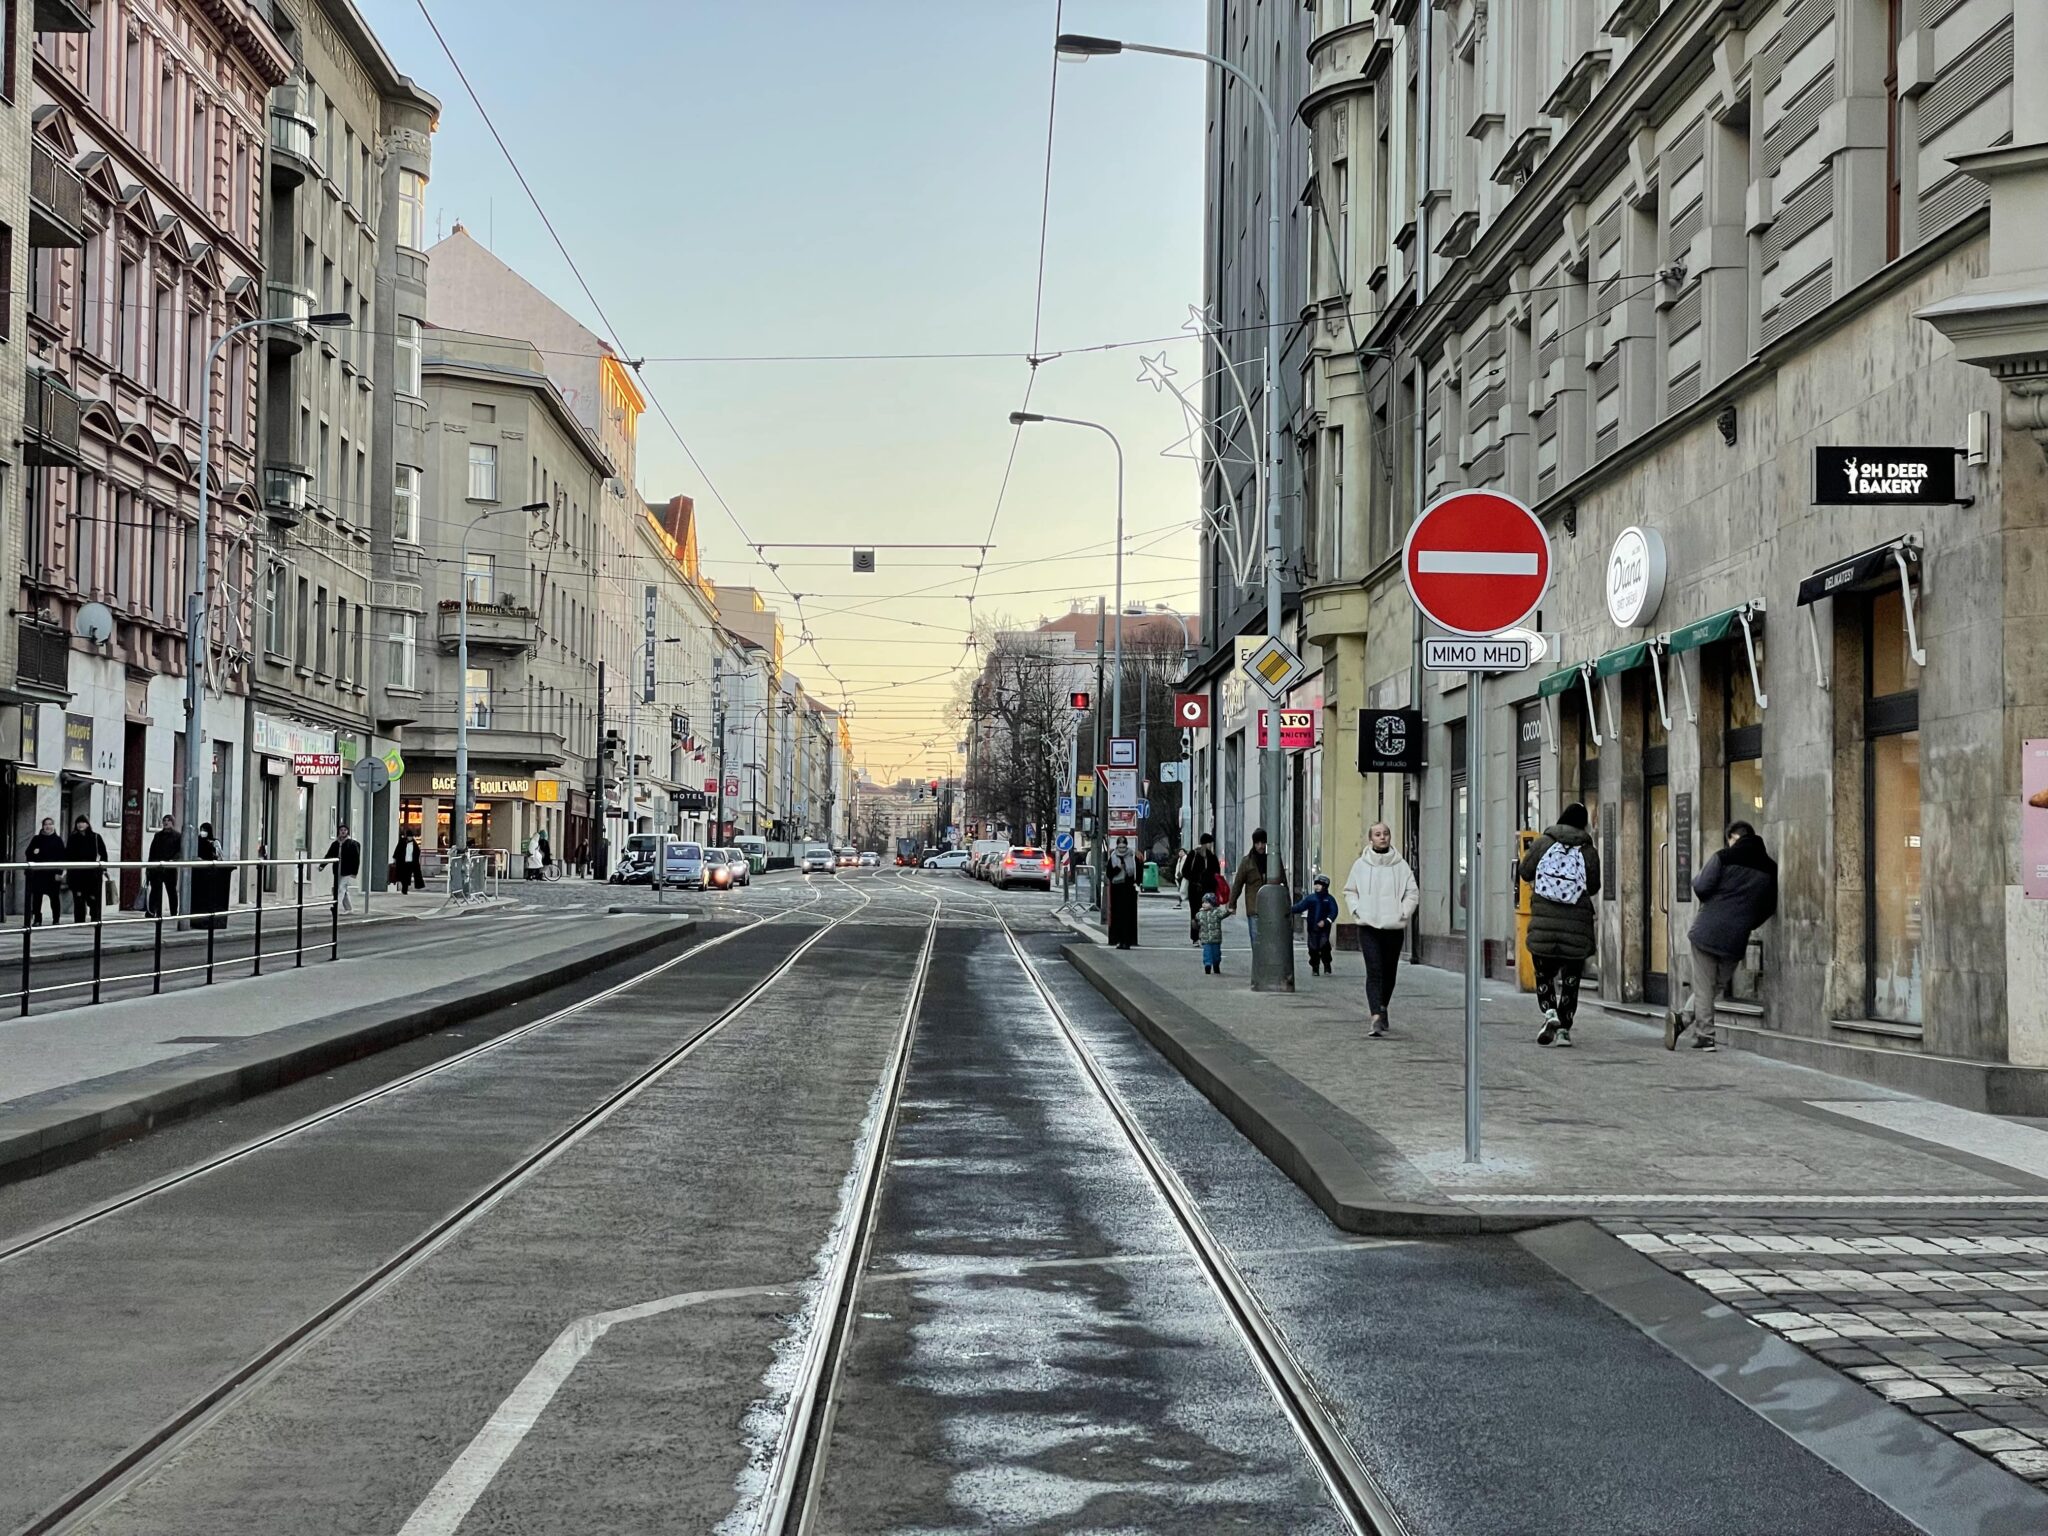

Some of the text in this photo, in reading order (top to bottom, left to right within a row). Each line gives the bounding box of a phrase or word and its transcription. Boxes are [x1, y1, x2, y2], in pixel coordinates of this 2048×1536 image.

[1860, 463, 1928, 478] OH DEER
[1859, 479, 1922, 494] BAKERY
[1613, 555, 1641, 595] Diana
[645, 596, 656, 691] HOTEL
[1433, 646, 1522, 662] MIMO MHD
[713, 666, 721, 739] HOTEL
[295, 755, 313, 764] NON
[319, 755, 340, 765] STOP
[1386, 759, 1407, 767] studio
[295, 766, 339, 775] POTRAVINY
[480, 780, 529, 794] BOULEVARD
